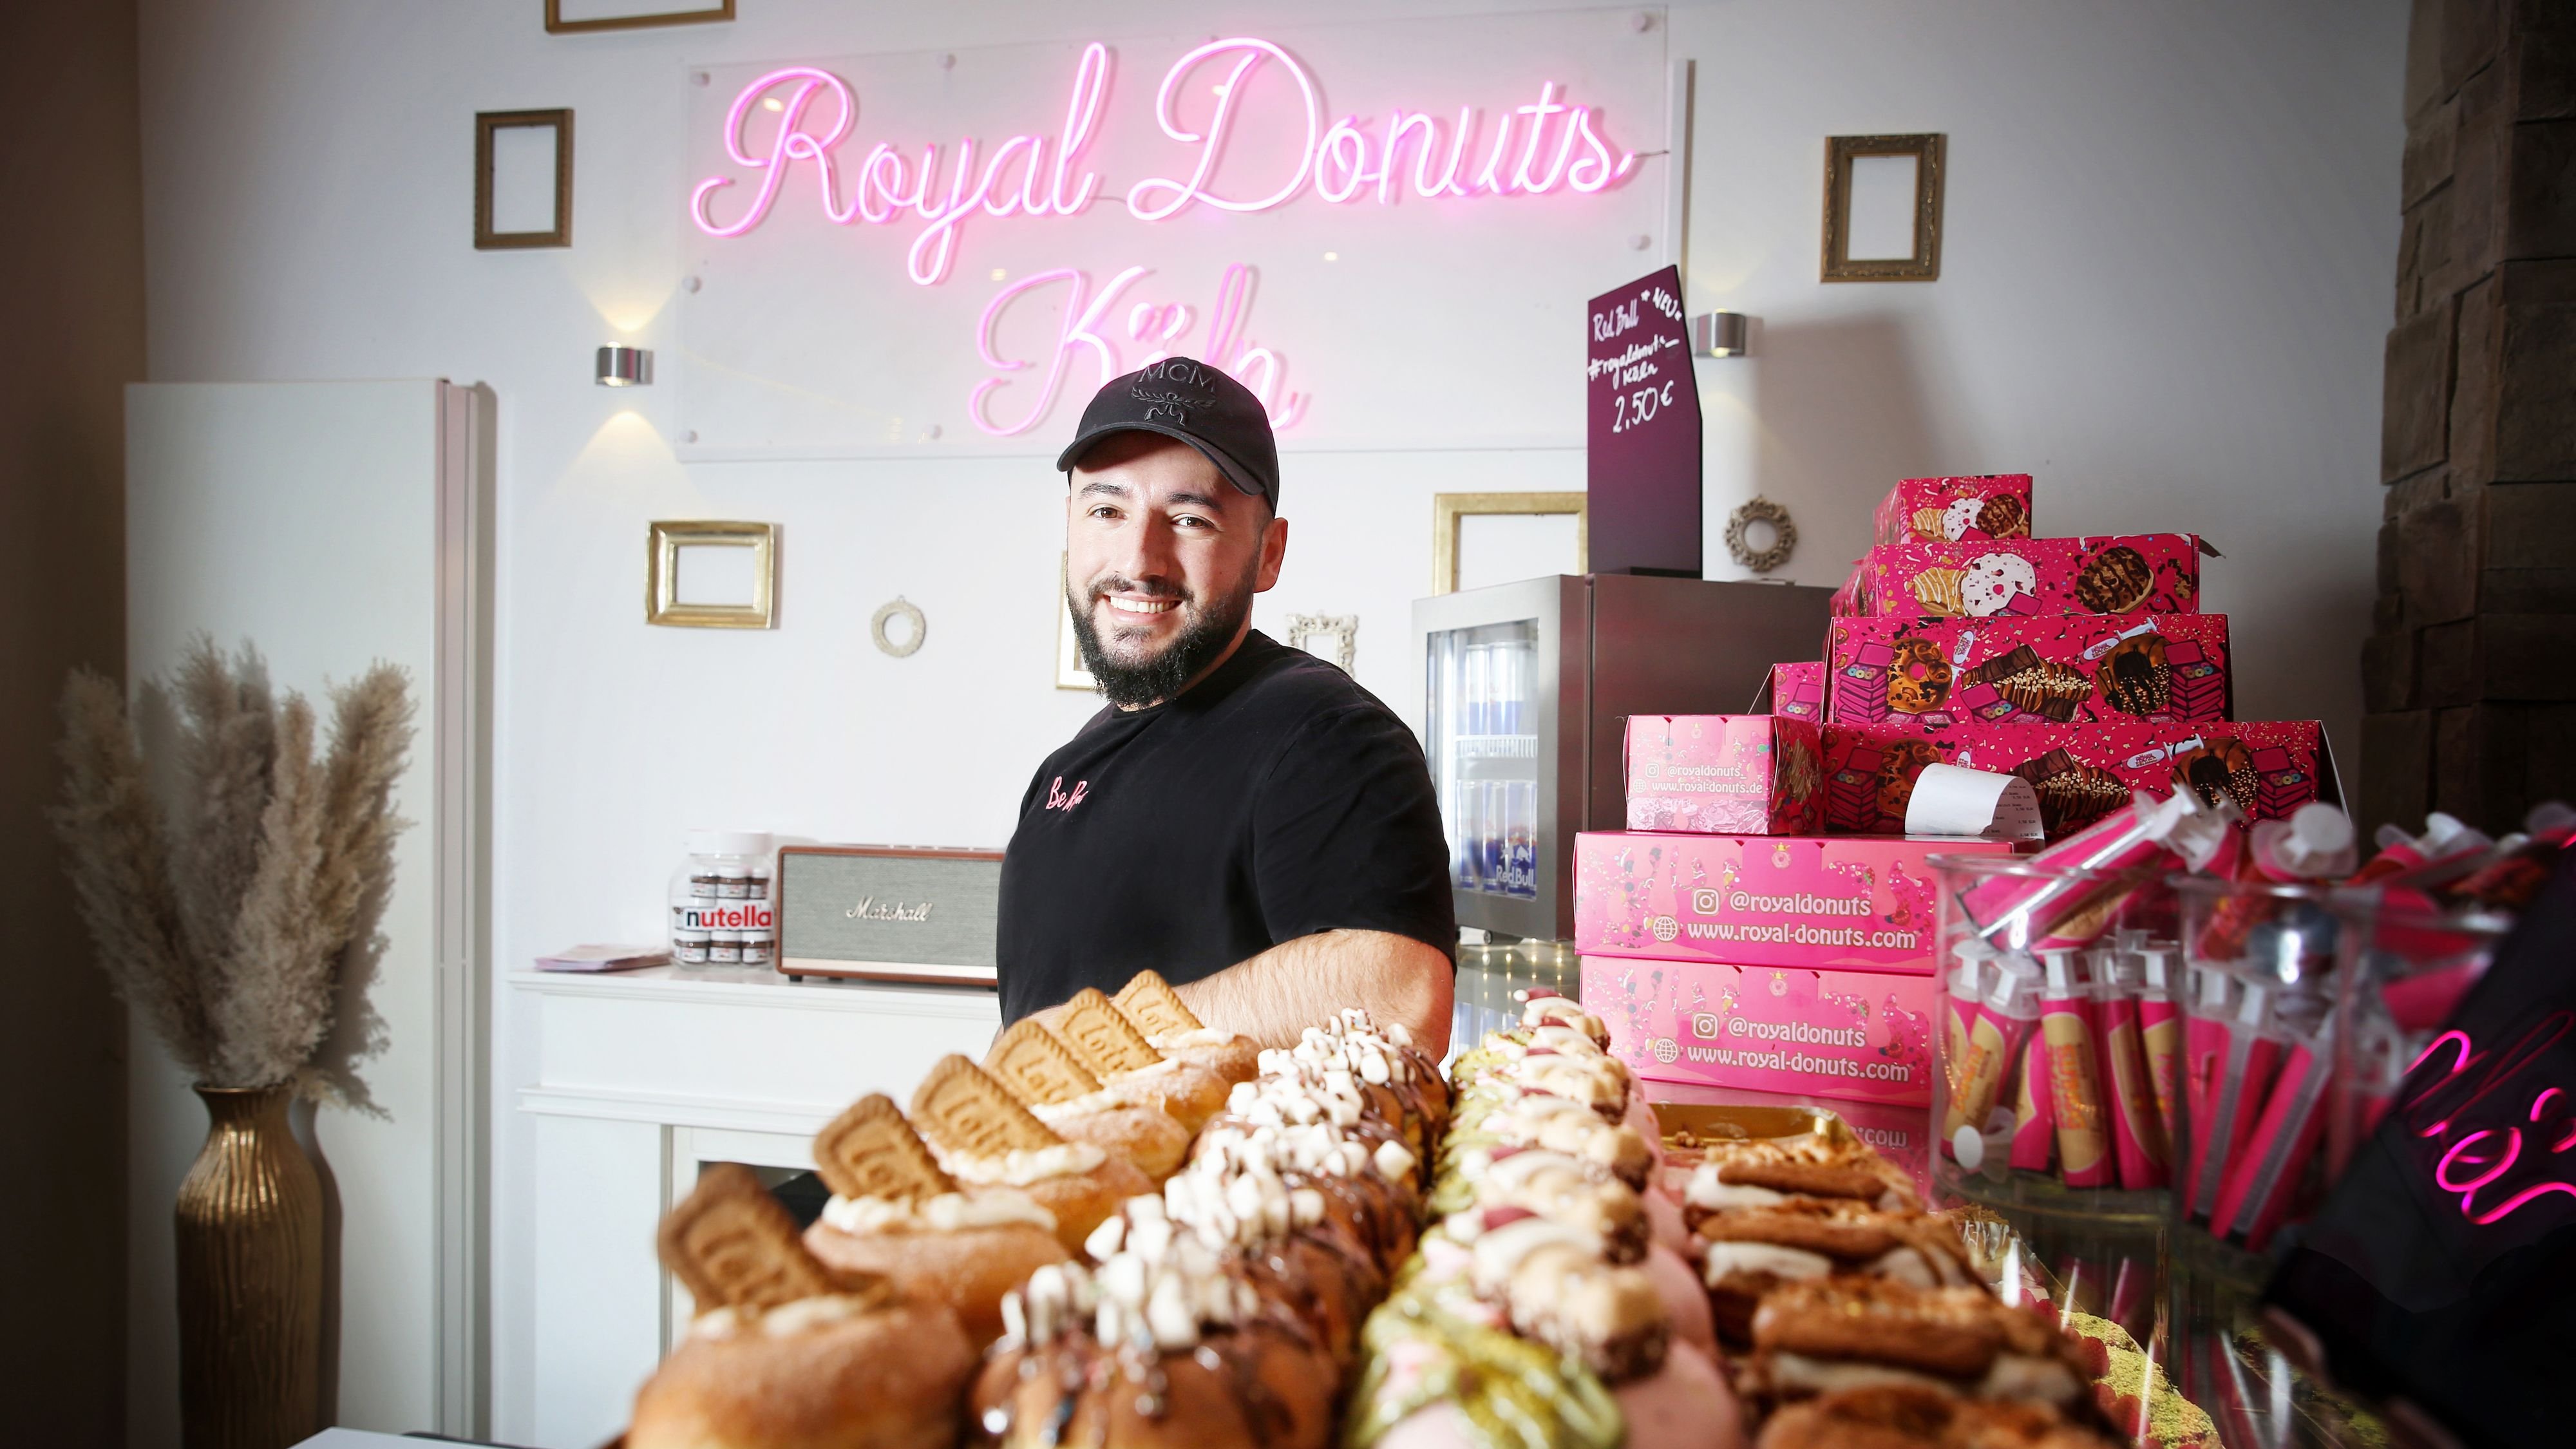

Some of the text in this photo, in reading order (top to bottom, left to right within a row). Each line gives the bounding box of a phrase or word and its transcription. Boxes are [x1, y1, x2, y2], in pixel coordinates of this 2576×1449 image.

[690, 36, 1636, 285] Royal Donuts
[1652, 287, 1679, 319] NEU
[1593, 308, 1615, 343] Red
[1137, 361, 1216, 393] MCM
[1651, 781, 1763, 794] www.royal-donuts.de
[1496, 864, 1534, 887] Red Bull
[687, 905, 772, 927] nutella
[846, 895, 934, 922] Marshall
[1729, 890, 1871, 917] @royaldonuts
[1687, 922, 1917, 949] www.royal-donuts.com
[1728, 1016, 1866, 1048] @royaldonuts
[1687, 1045, 1910, 1083] www.royal-donuts.com
